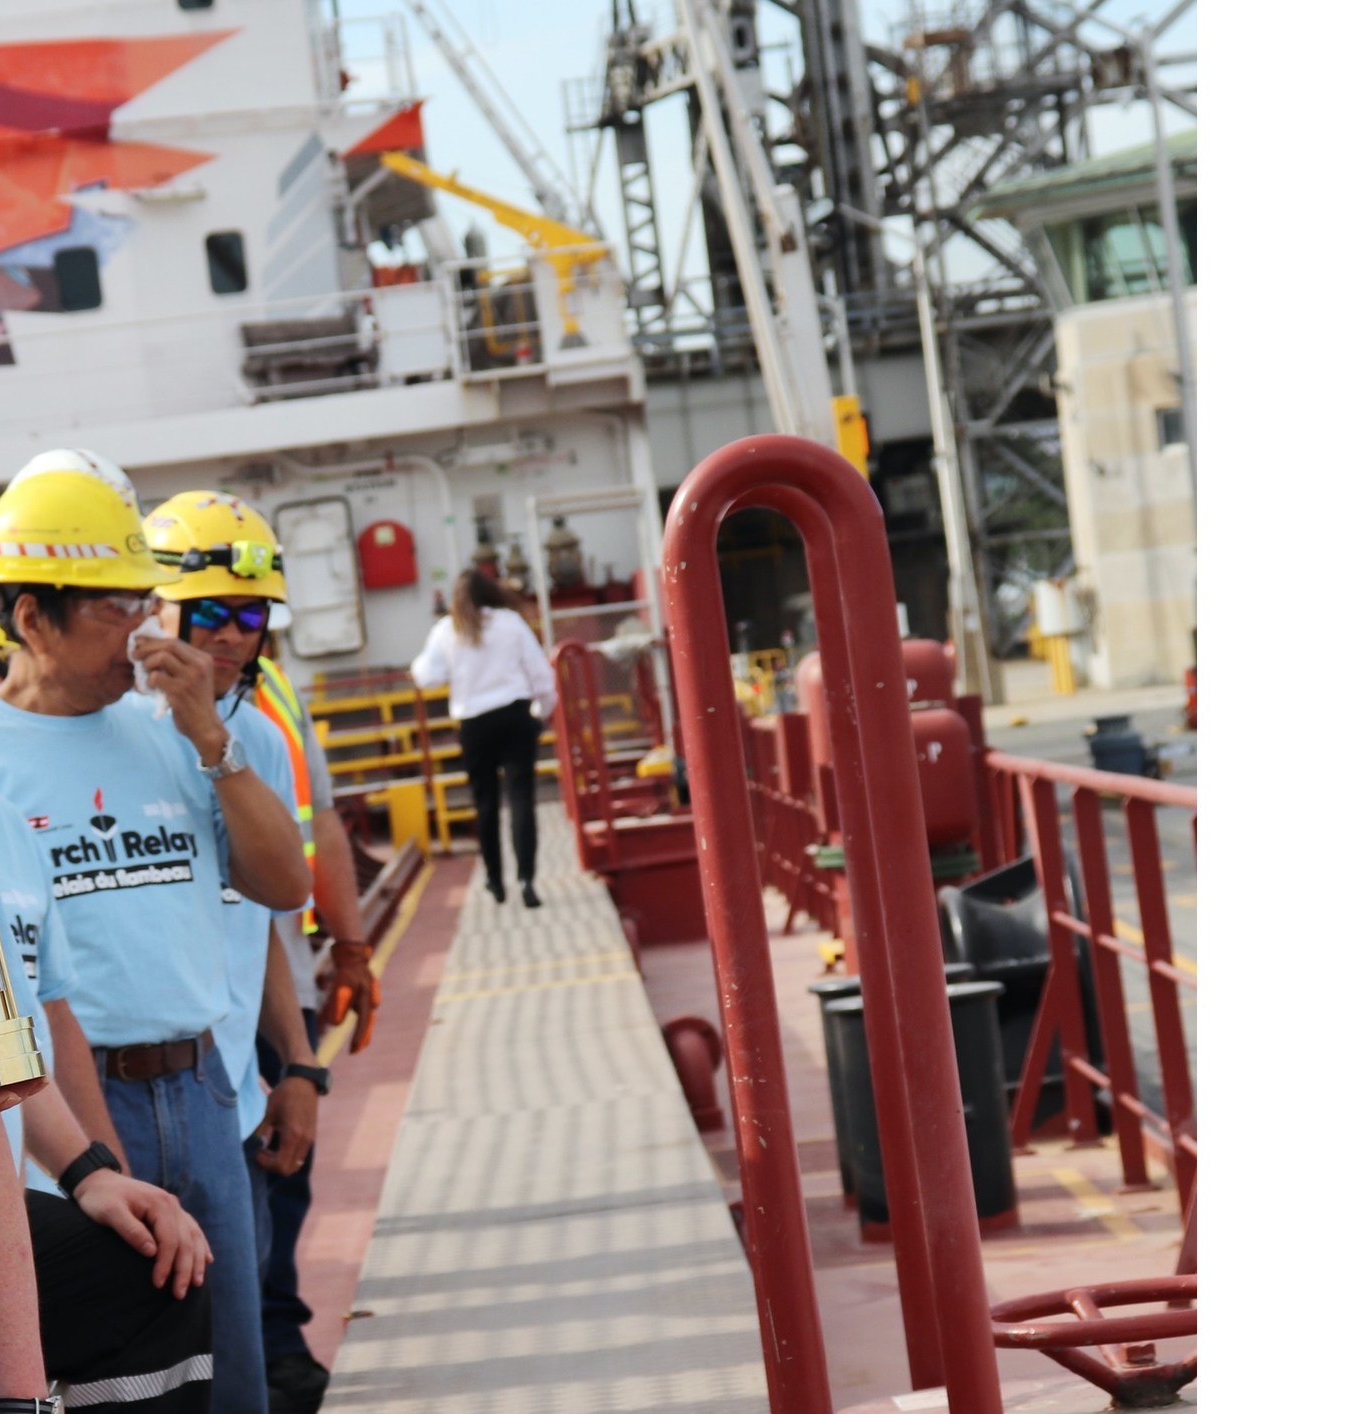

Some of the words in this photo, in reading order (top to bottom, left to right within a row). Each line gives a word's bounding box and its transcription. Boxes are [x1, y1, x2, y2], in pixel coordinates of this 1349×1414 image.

[51, 836, 101, 867] rch
[122, 826, 198, 858] Relay
[53, 875, 96, 899] elais
